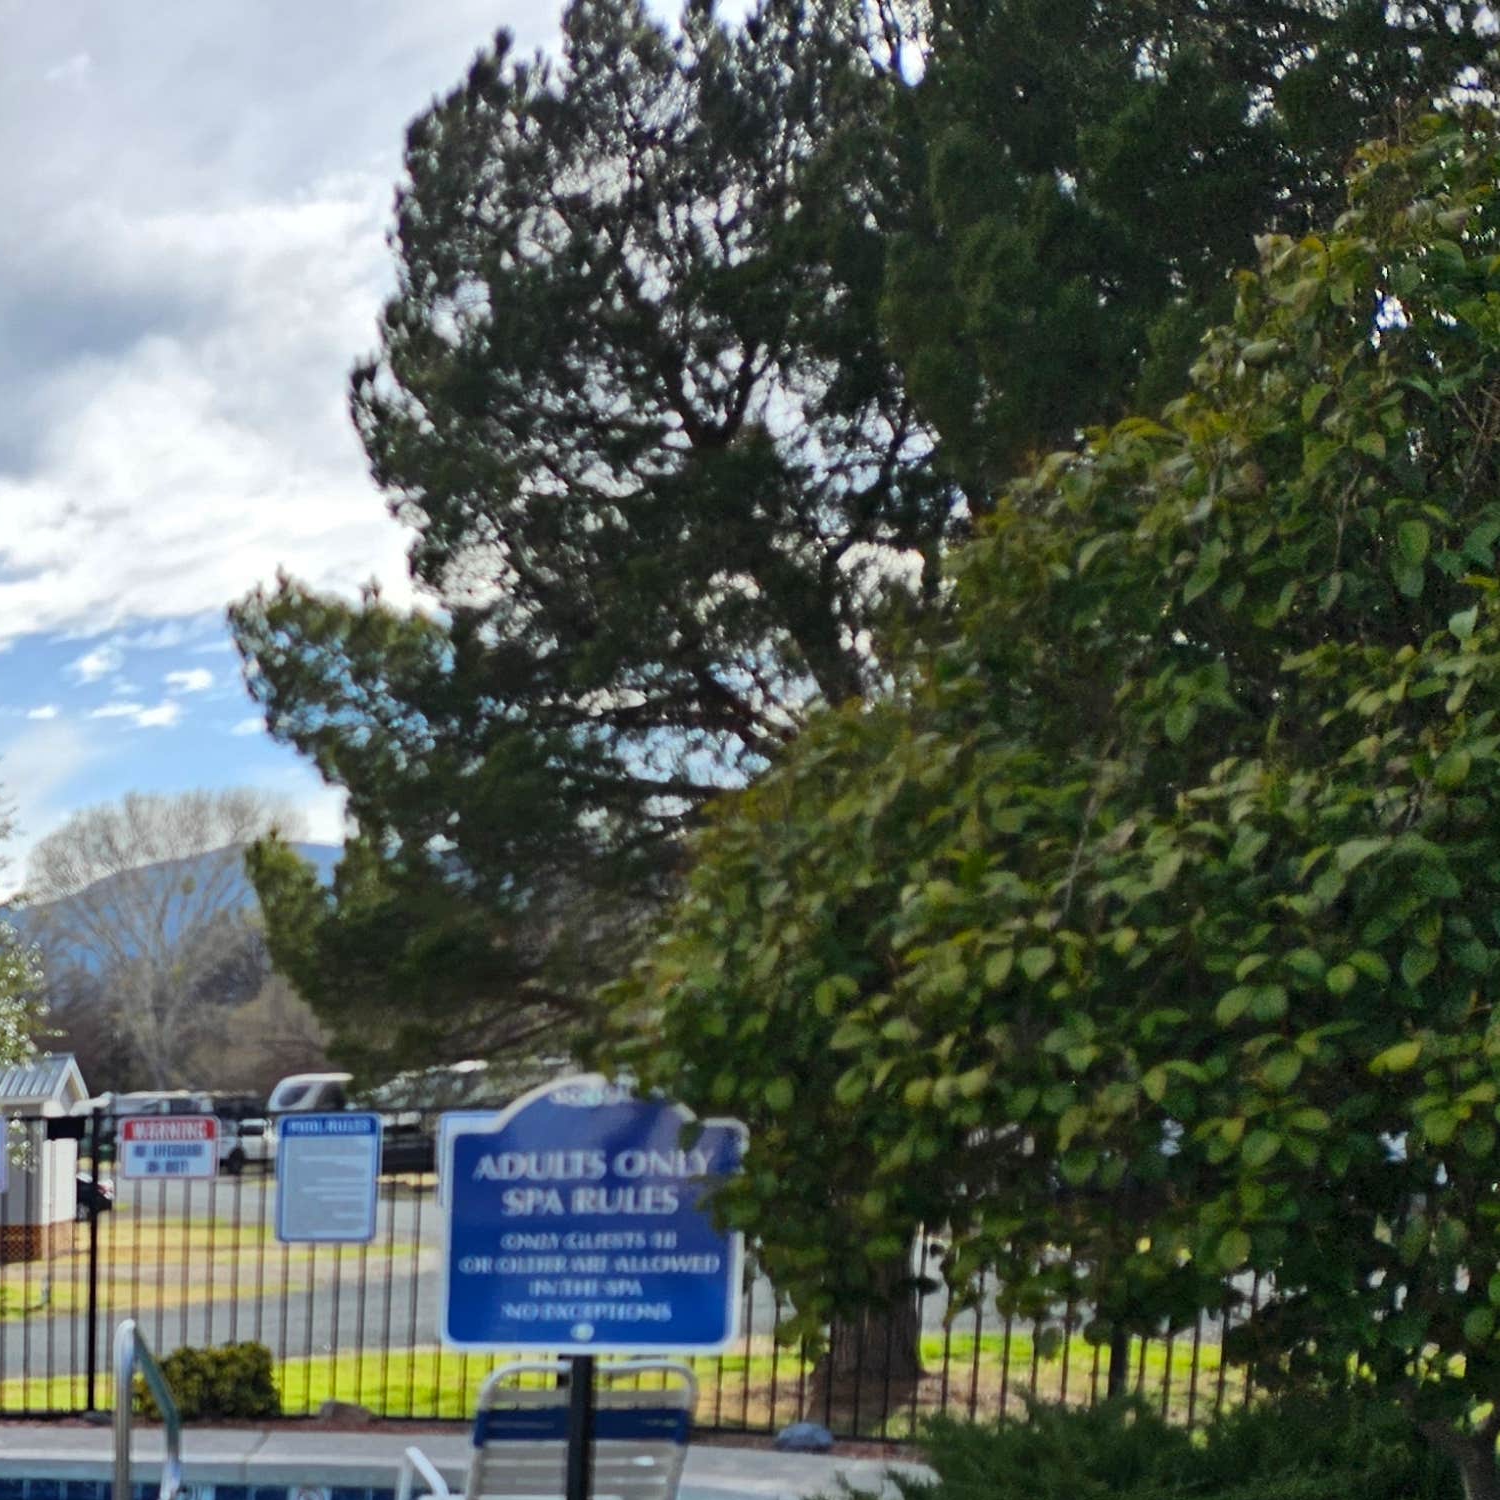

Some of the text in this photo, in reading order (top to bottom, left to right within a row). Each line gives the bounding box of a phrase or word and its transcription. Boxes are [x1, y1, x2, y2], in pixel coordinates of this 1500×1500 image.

[134, 1120, 206, 1139] WARNING
[473, 1149, 715, 1181] ADULTS ONLY
[501, 1185, 680, 1217] SPA RULES
[500, 1232, 560, 1250] ONLY
[562, 1231, 647, 1250] GUESTS
[458, 1254, 721, 1274] OR OLDER ARE ALLOWED
[528, 1278, 644, 1298] IN THE SPA
[501, 1302, 673, 1322] NO EXCEPTIONS
